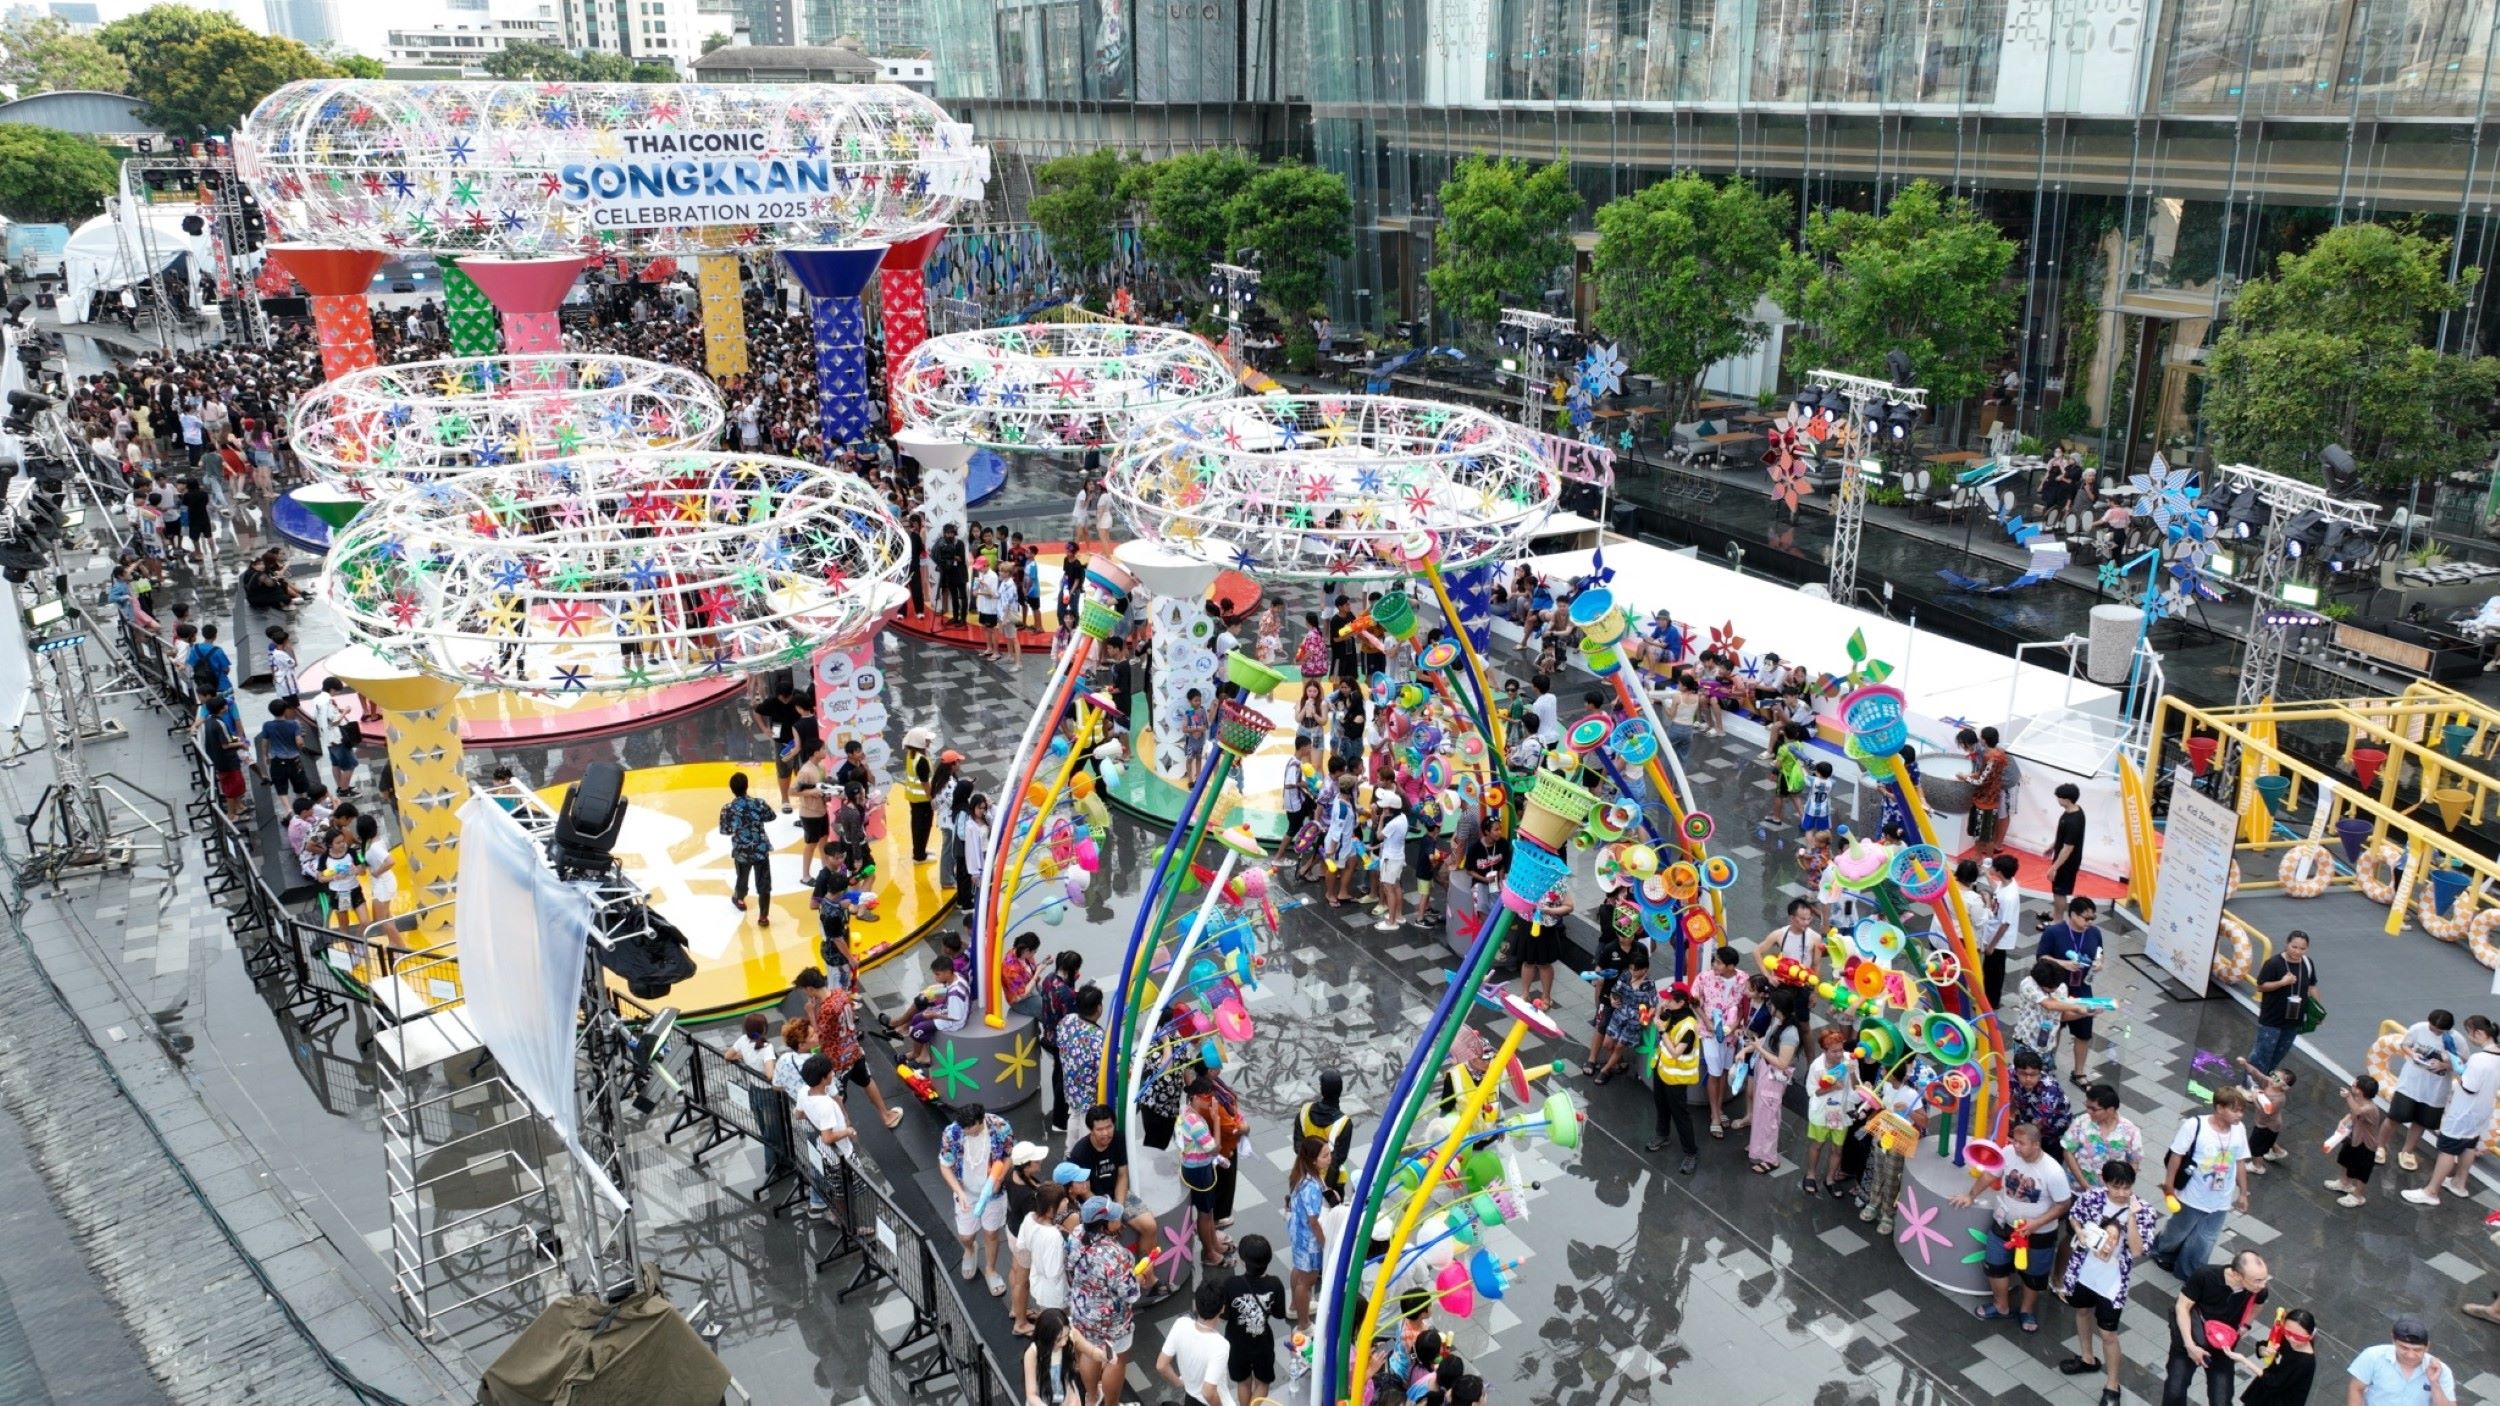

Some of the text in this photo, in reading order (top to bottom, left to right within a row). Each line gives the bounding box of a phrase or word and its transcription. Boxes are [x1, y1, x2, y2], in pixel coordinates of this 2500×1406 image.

[624, 133, 765, 154] THAICONIC
[562, 158, 830, 200] SONGKRAN
[594, 201, 808, 226] CELEBRATION 2025
[1814, 791, 1828, 804] 10
